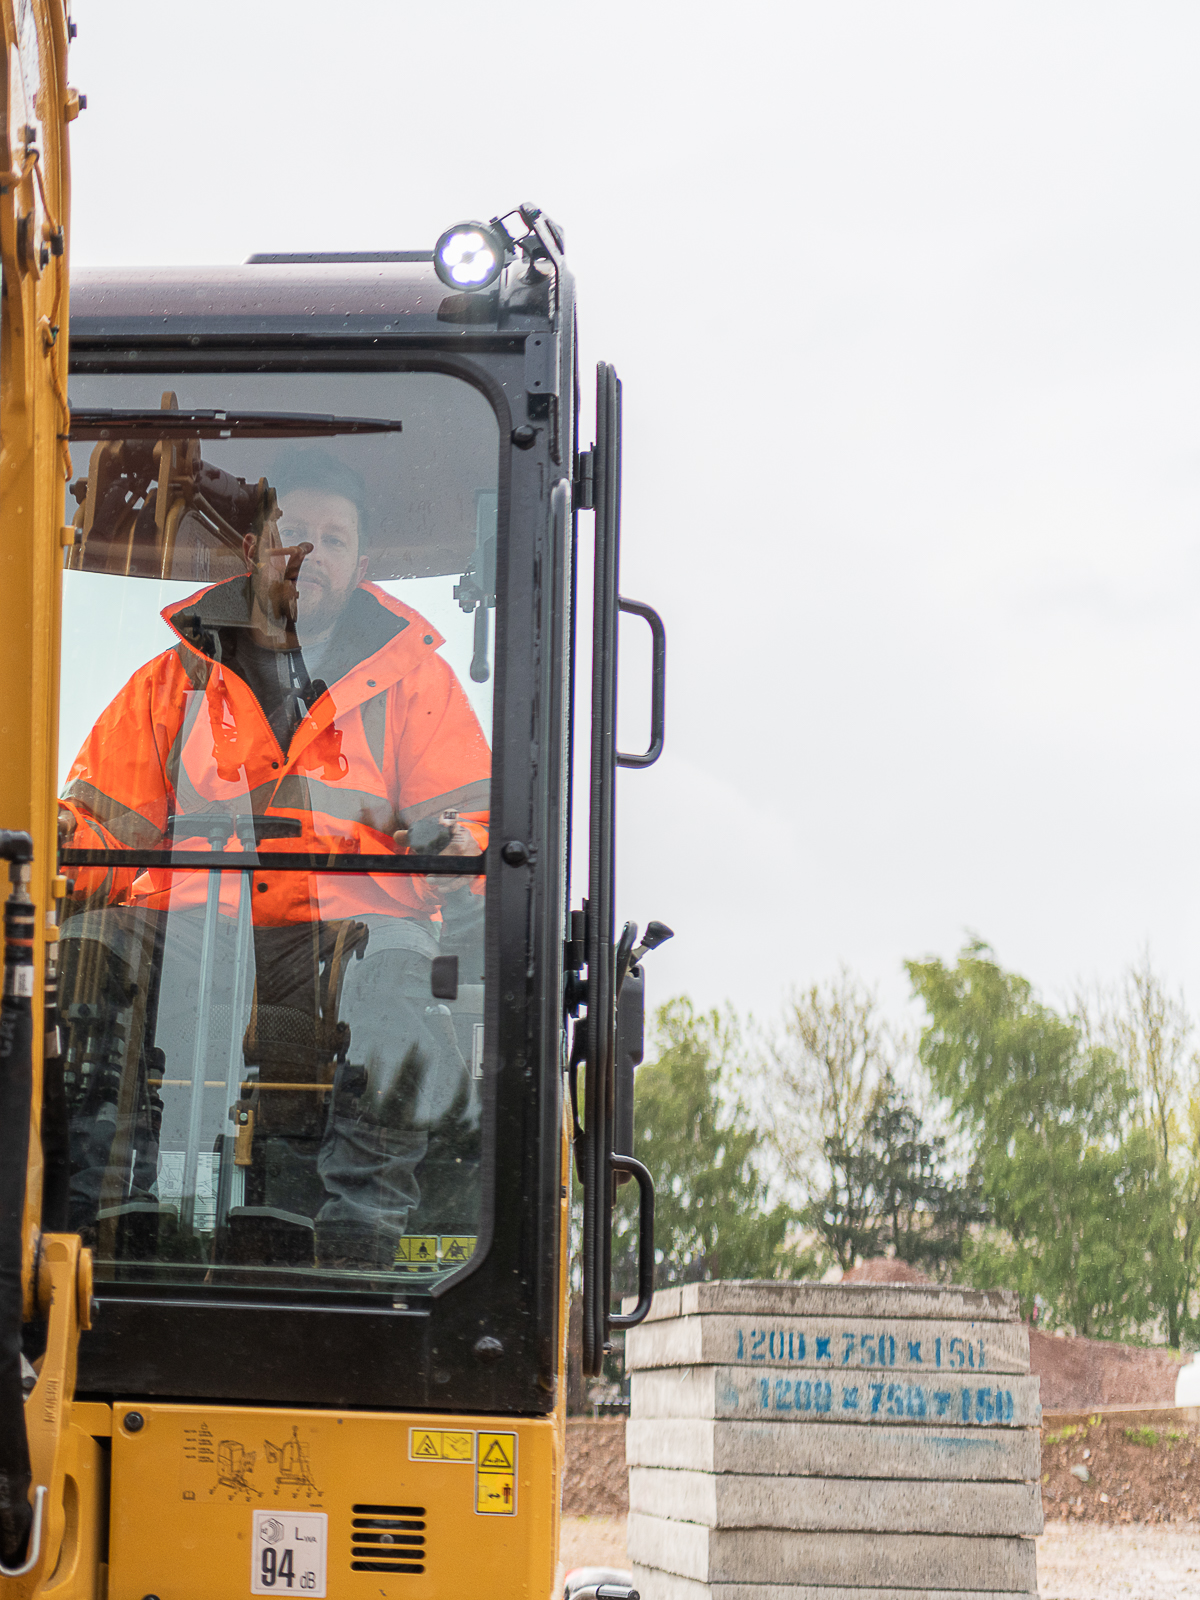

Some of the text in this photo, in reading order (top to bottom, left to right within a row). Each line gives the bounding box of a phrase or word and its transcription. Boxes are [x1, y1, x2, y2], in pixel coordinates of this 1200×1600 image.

[736, 1328, 806, 1361] 1200
[841, 1332, 896, 1366] 750
[934, 1336, 986, 1369] 150
[760, 1377, 832, 1412] 1200
[867, 1383, 926, 1416] 750
[961, 1387, 1014, 1422] 150
[261, 1547, 317, 1589] 94 dB
